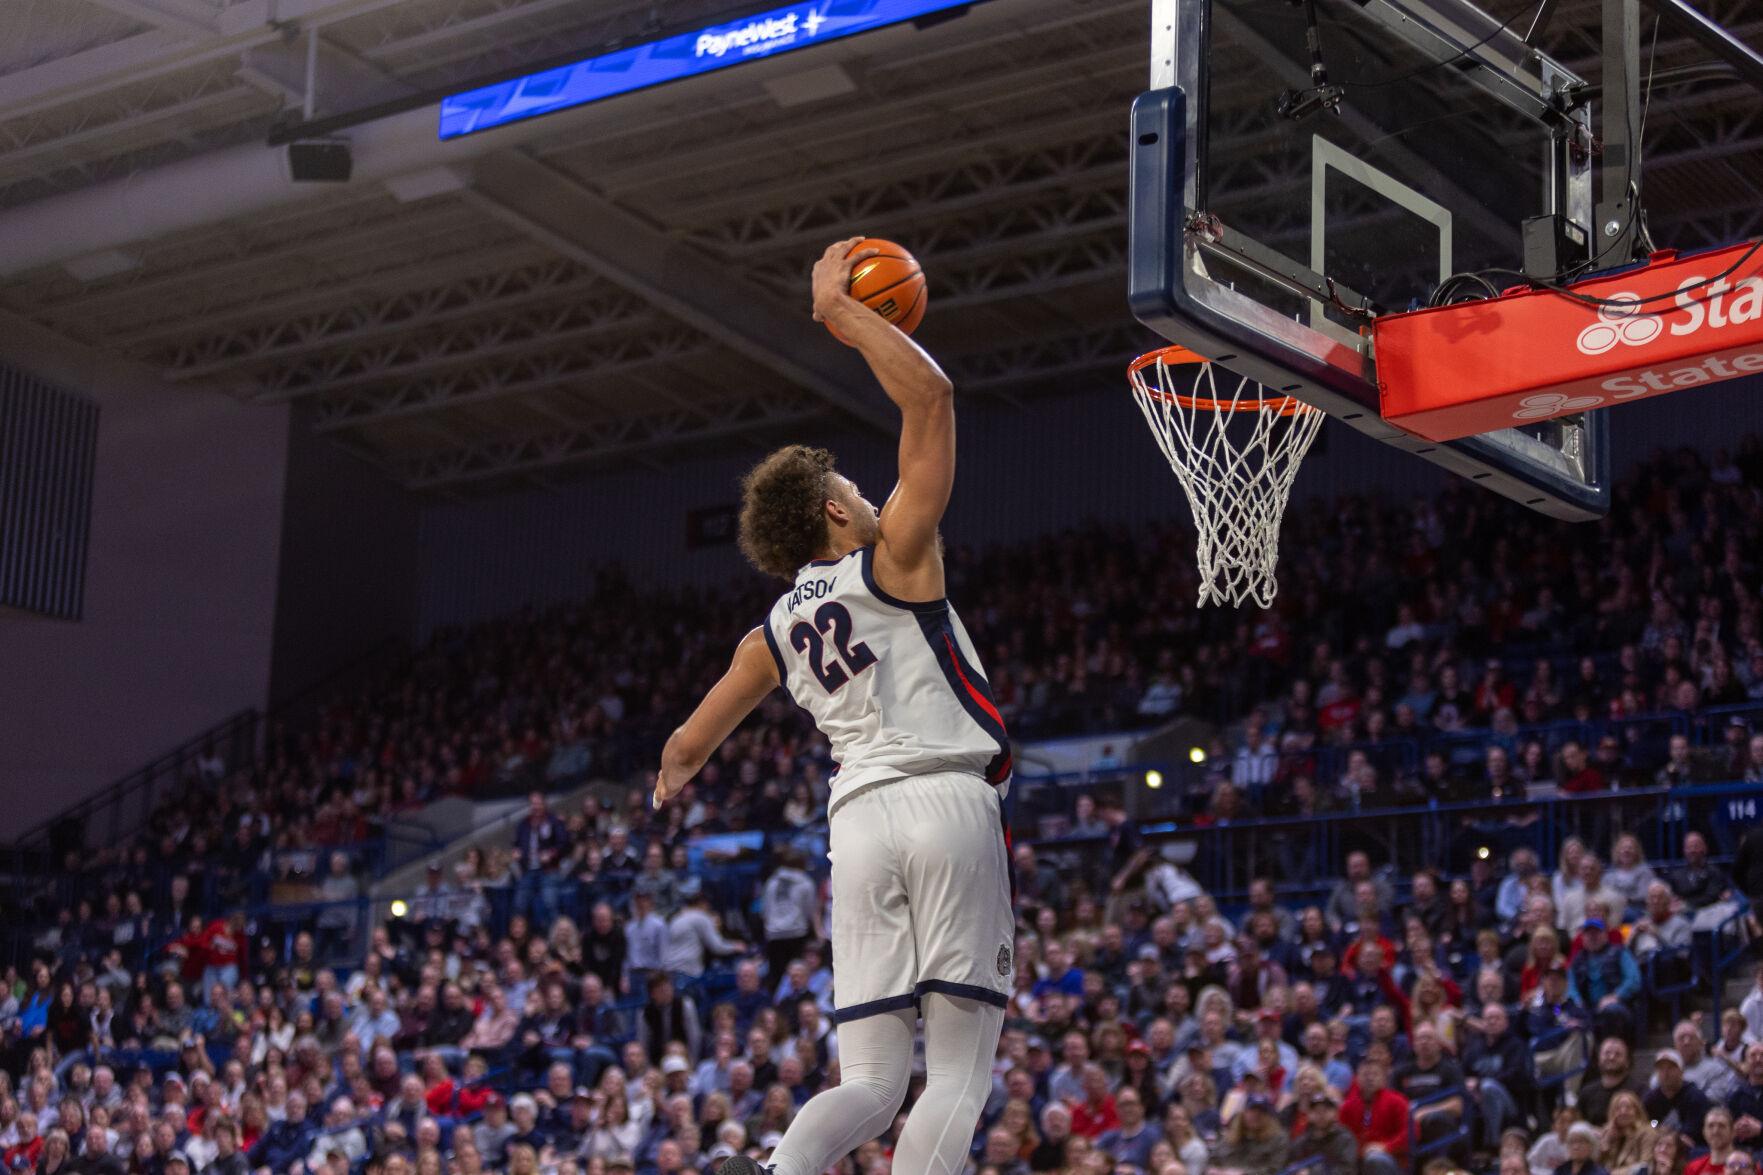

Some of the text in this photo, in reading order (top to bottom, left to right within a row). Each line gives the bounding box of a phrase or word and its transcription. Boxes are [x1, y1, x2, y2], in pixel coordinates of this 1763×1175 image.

[695, 12, 799, 58] PayneWest
[1601, 353, 1763, 399] State
[789, 601, 879, 695] 22
